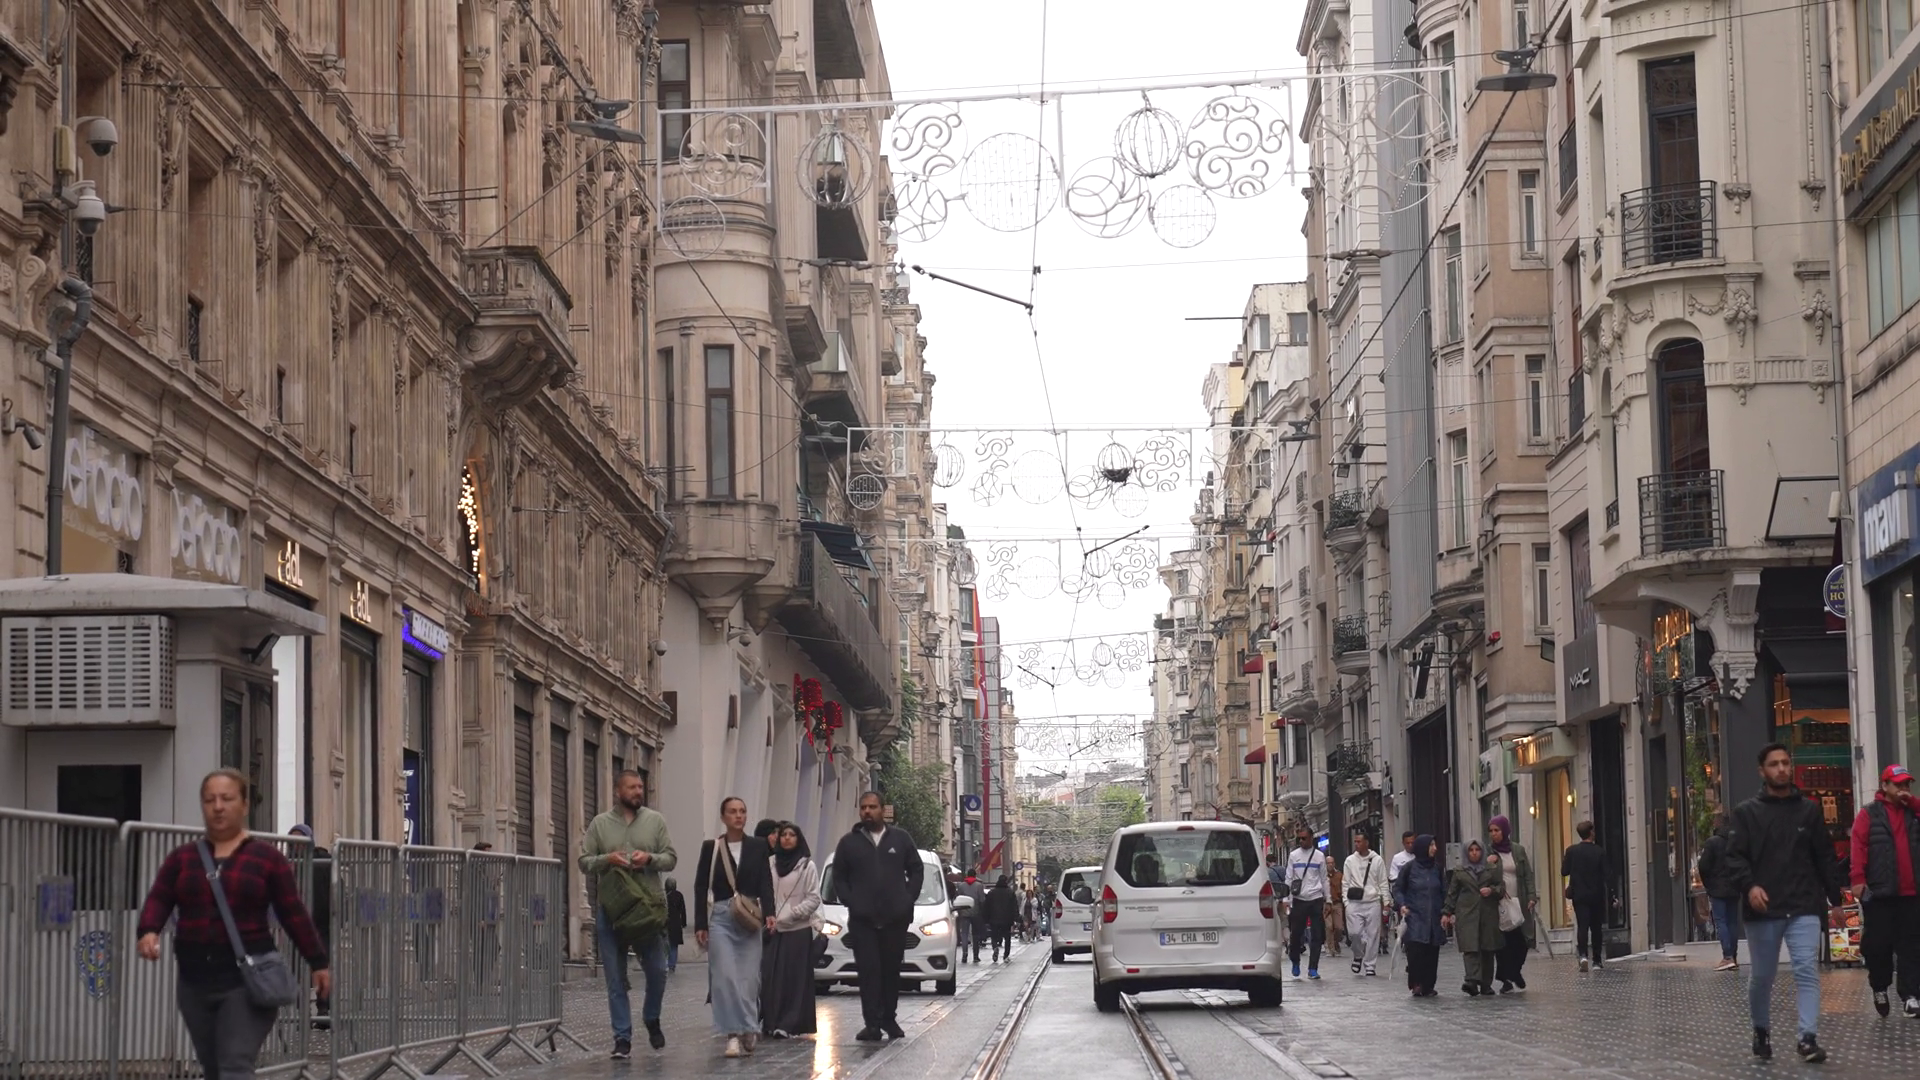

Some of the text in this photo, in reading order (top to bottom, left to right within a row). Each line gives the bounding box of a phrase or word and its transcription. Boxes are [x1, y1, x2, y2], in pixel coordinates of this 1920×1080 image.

[64, 425, 142, 541] eFacto
[1864, 471, 1909, 559] mavi
[1830, 592, 1845, 600] HO
[1166, 931, 1216, 943] 34 CHA 180
